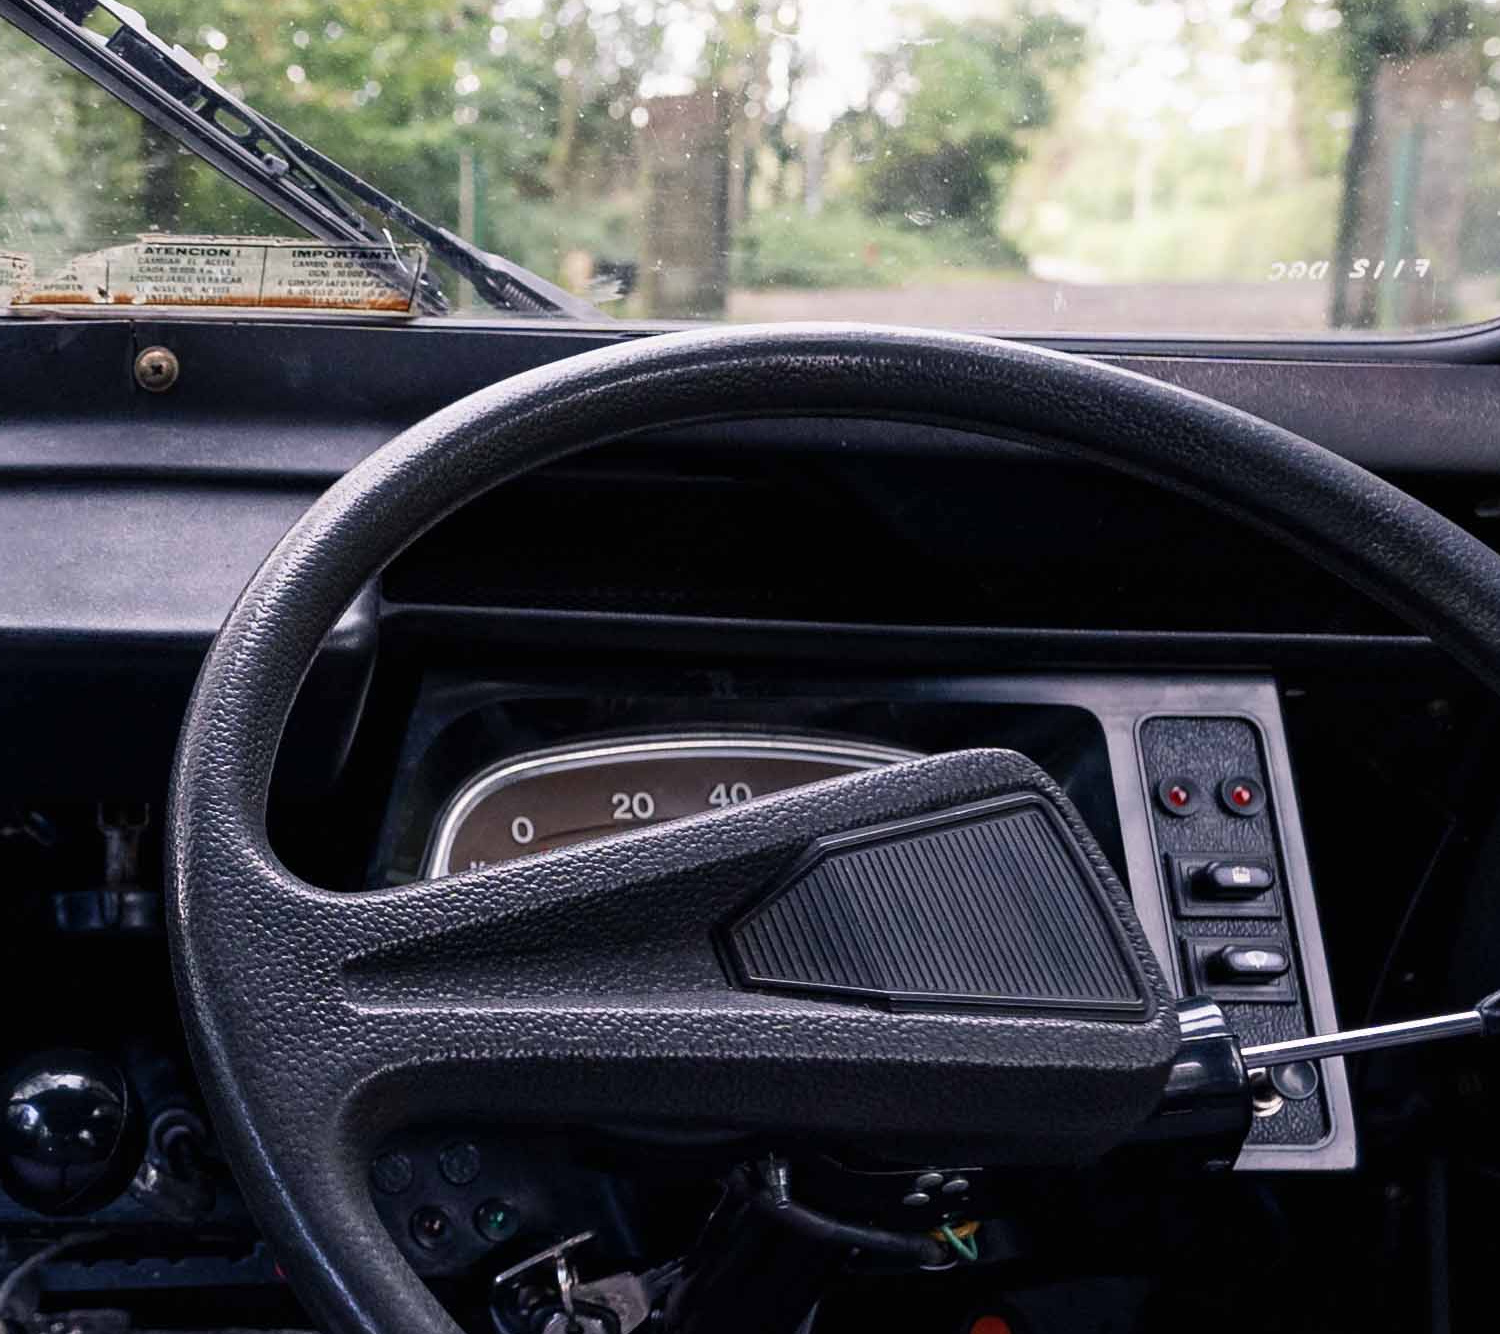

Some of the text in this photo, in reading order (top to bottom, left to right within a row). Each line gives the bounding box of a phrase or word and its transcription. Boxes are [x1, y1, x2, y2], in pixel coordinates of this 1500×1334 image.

[144, 246, 231, 256] ATENCION
[611, 791, 656, 820] 20
[708, 782, 753, 807] 40
[511, 815, 535, 844] 0
